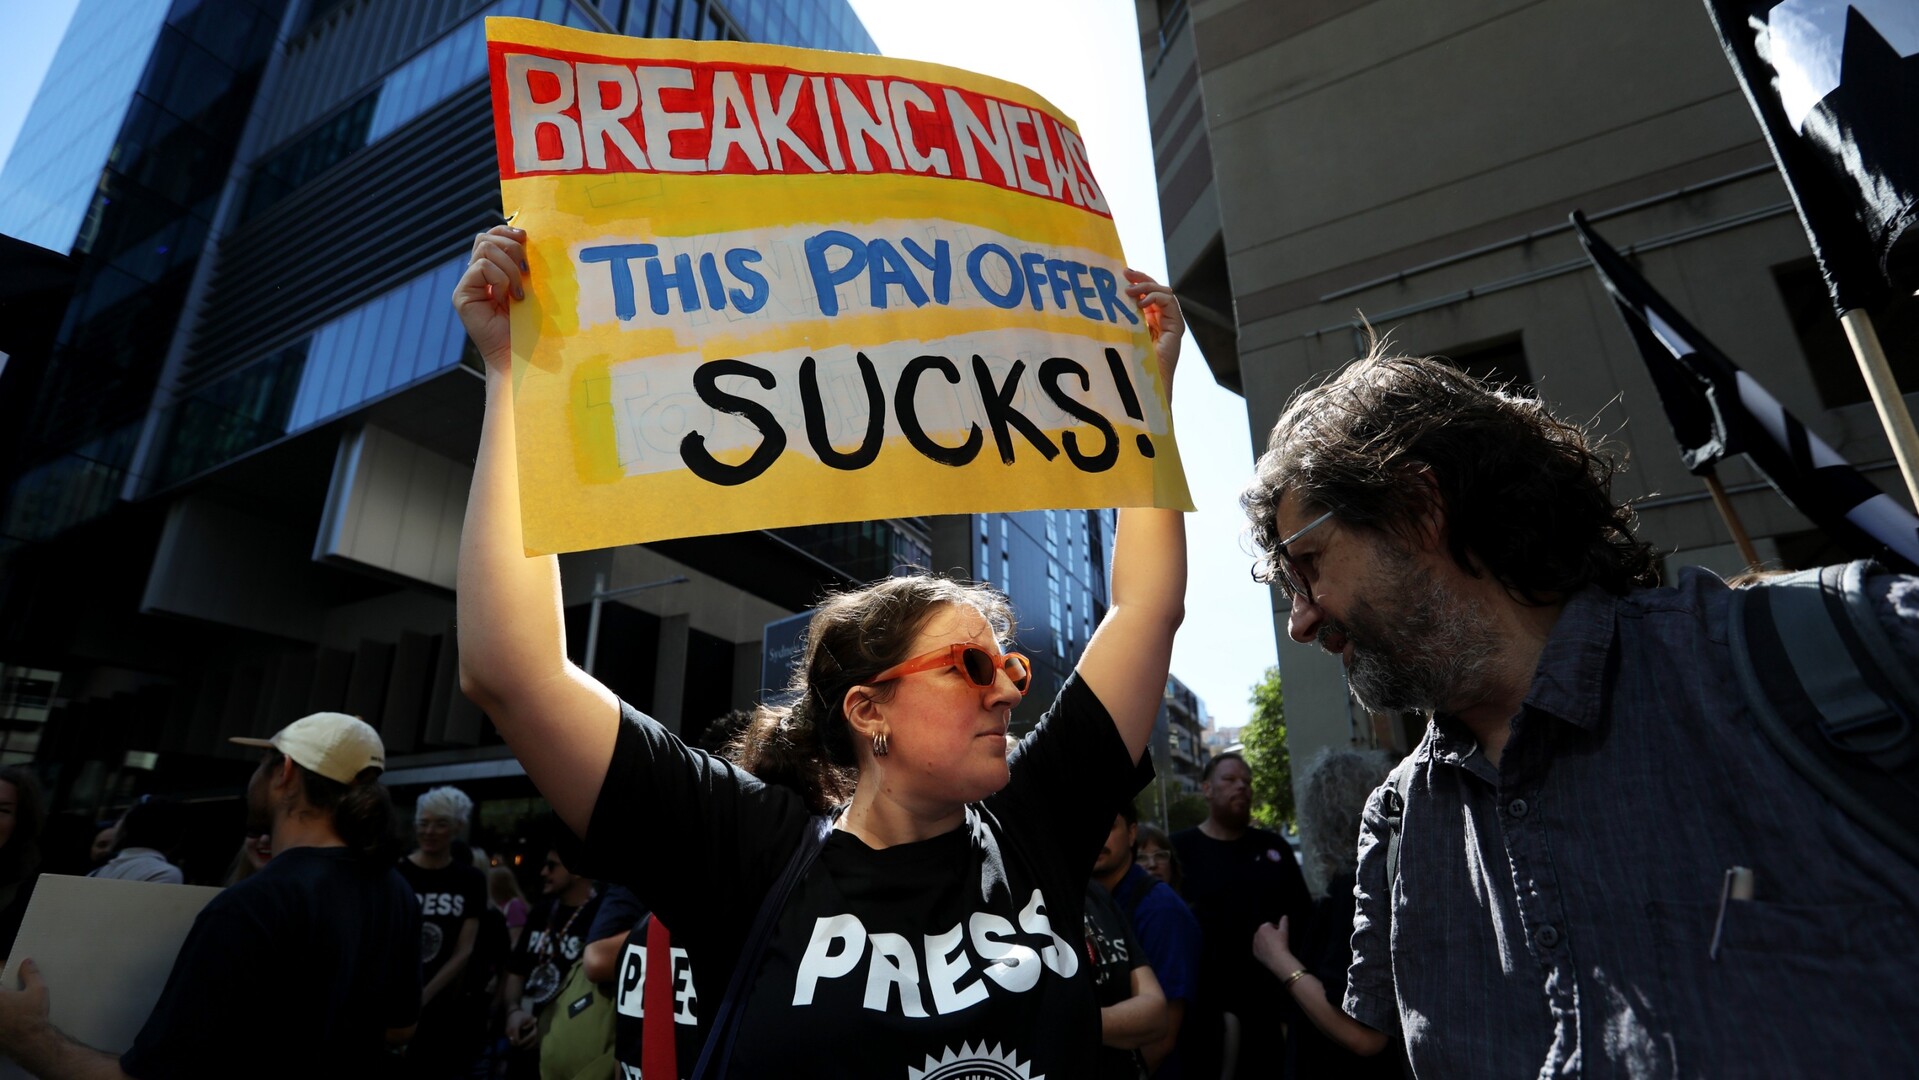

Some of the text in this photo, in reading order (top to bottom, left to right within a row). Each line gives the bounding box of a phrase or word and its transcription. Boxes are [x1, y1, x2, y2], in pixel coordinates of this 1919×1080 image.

[505, 52, 1110, 215] BREAKING NEWS
[579, 243, 770, 321] THIS
[804, 230, 950, 317] PAY
[966, 242, 1139, 325] OFFER
[679, 348, 1156, 486] SUCKS!
[414, 891, 466, 918] ESS
[791, 888, 1079, 1018] PRESS
